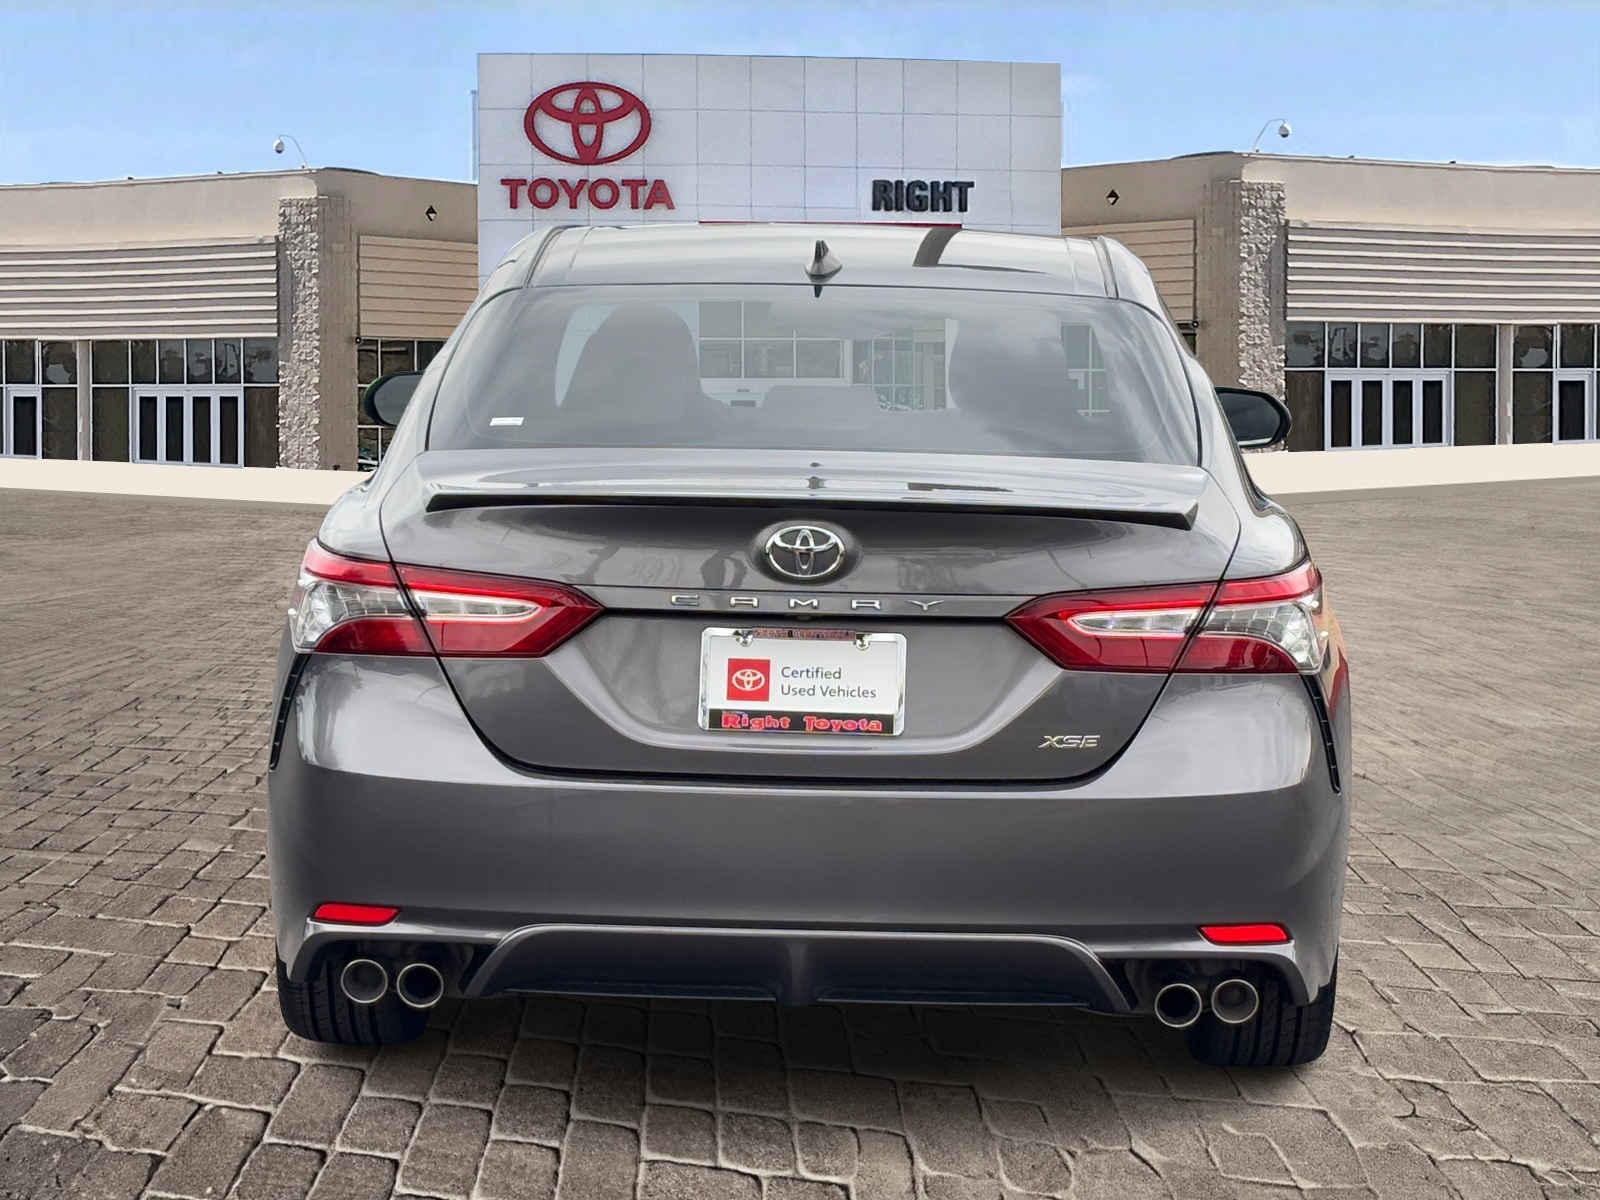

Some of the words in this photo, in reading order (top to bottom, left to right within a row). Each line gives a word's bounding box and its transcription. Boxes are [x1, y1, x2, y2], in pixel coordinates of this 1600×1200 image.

[501, 178, 674, 209] TOYOTA
[872, 180, 974, 212] RIGHT
[671, 594, 944, 611] CAMRY
[780, 665, 842, 680] Certified
[780, 684, 815, 697] Used
[820, 685, 876, 698] Vehicles
[721, 713, 791, 731] Right
[804, 715, 882, 732] Toyota
[1038, 734, 1100, 748] XSE
